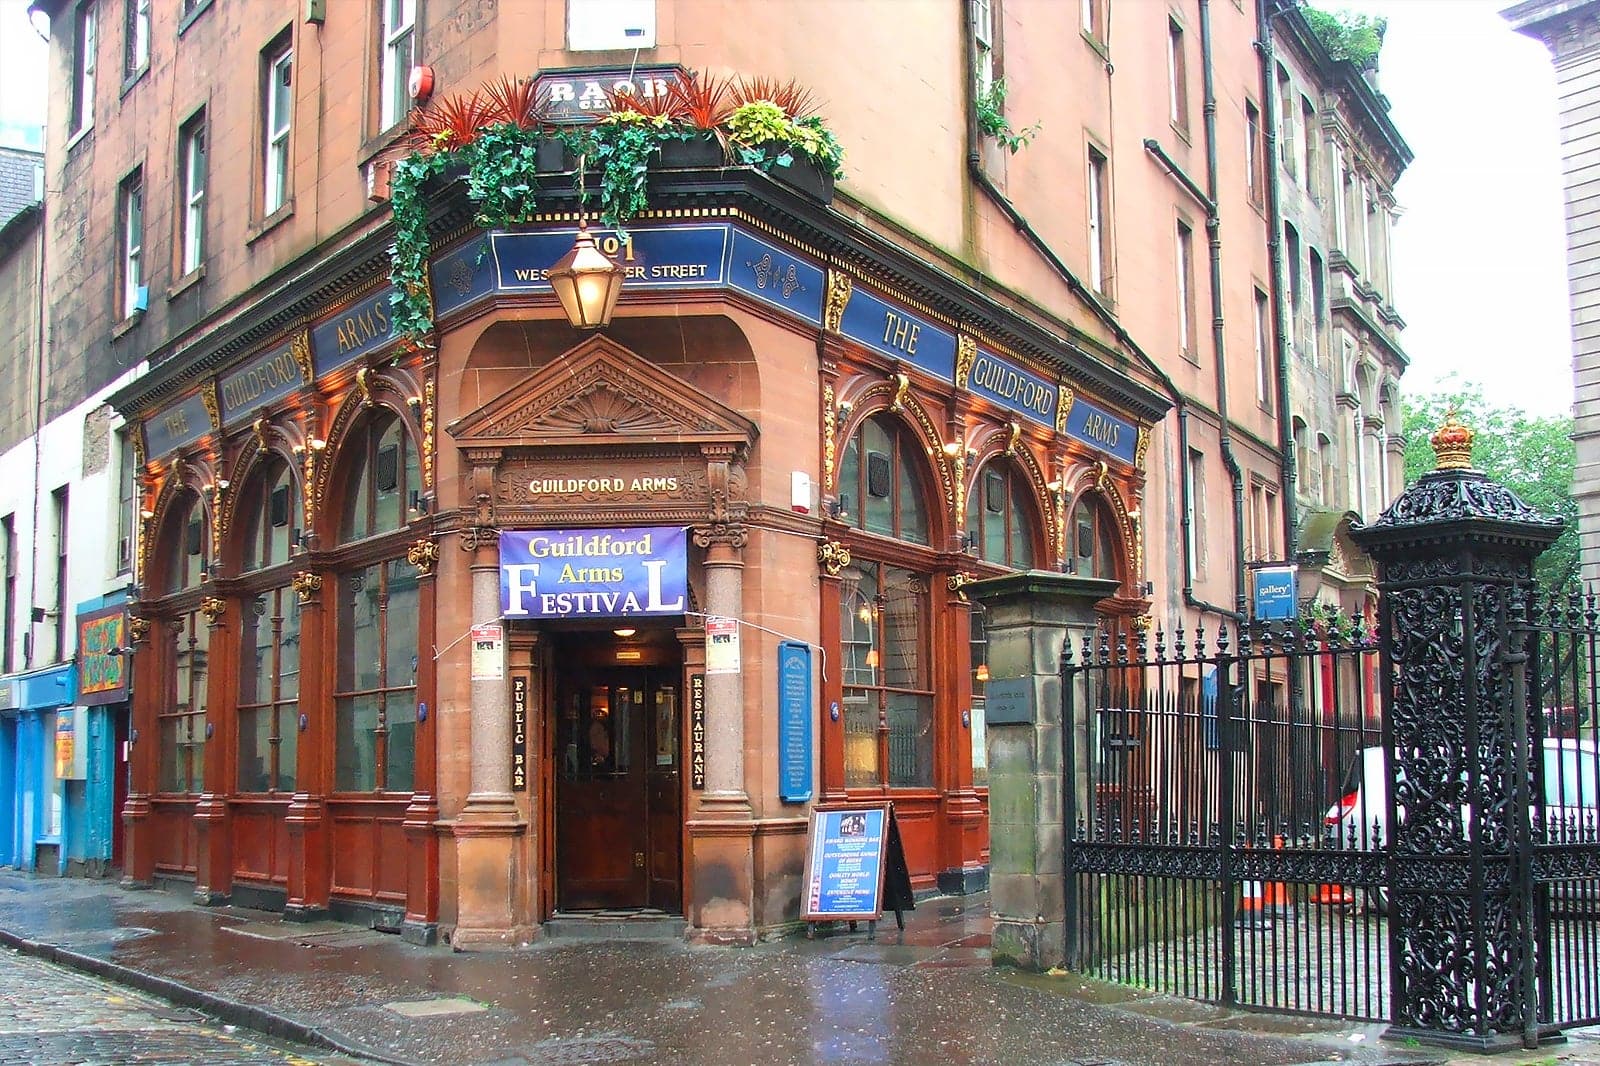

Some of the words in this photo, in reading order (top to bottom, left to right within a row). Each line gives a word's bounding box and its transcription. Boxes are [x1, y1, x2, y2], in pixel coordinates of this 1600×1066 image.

[549, 79, 668, 102] RAOB
[514, 268, 549, 281] WES
[651, 264, 708, 279] STREET
[164, 409, 189, 440] THE
[223, 351, 298, 411] GUILDFORD
[336, 302, 389, 355] ARMS
[883, 311, 921, 355] THE
[973, 357, 1053, 416] GUILDFORD
[1082, 411, 1120, 447] ARMS
[529, 479, 625, 495] GUILDFORD
[630, 477, 678, 492] ARMS
[528, 533, 652, 559] Guildford
[557, 563, 624, 584] Arms
[514, 681, 524, 744] PUBLIC
[693, 678, 704, 785] RESTAURANT
[514, 754, 524, 786] BAR
